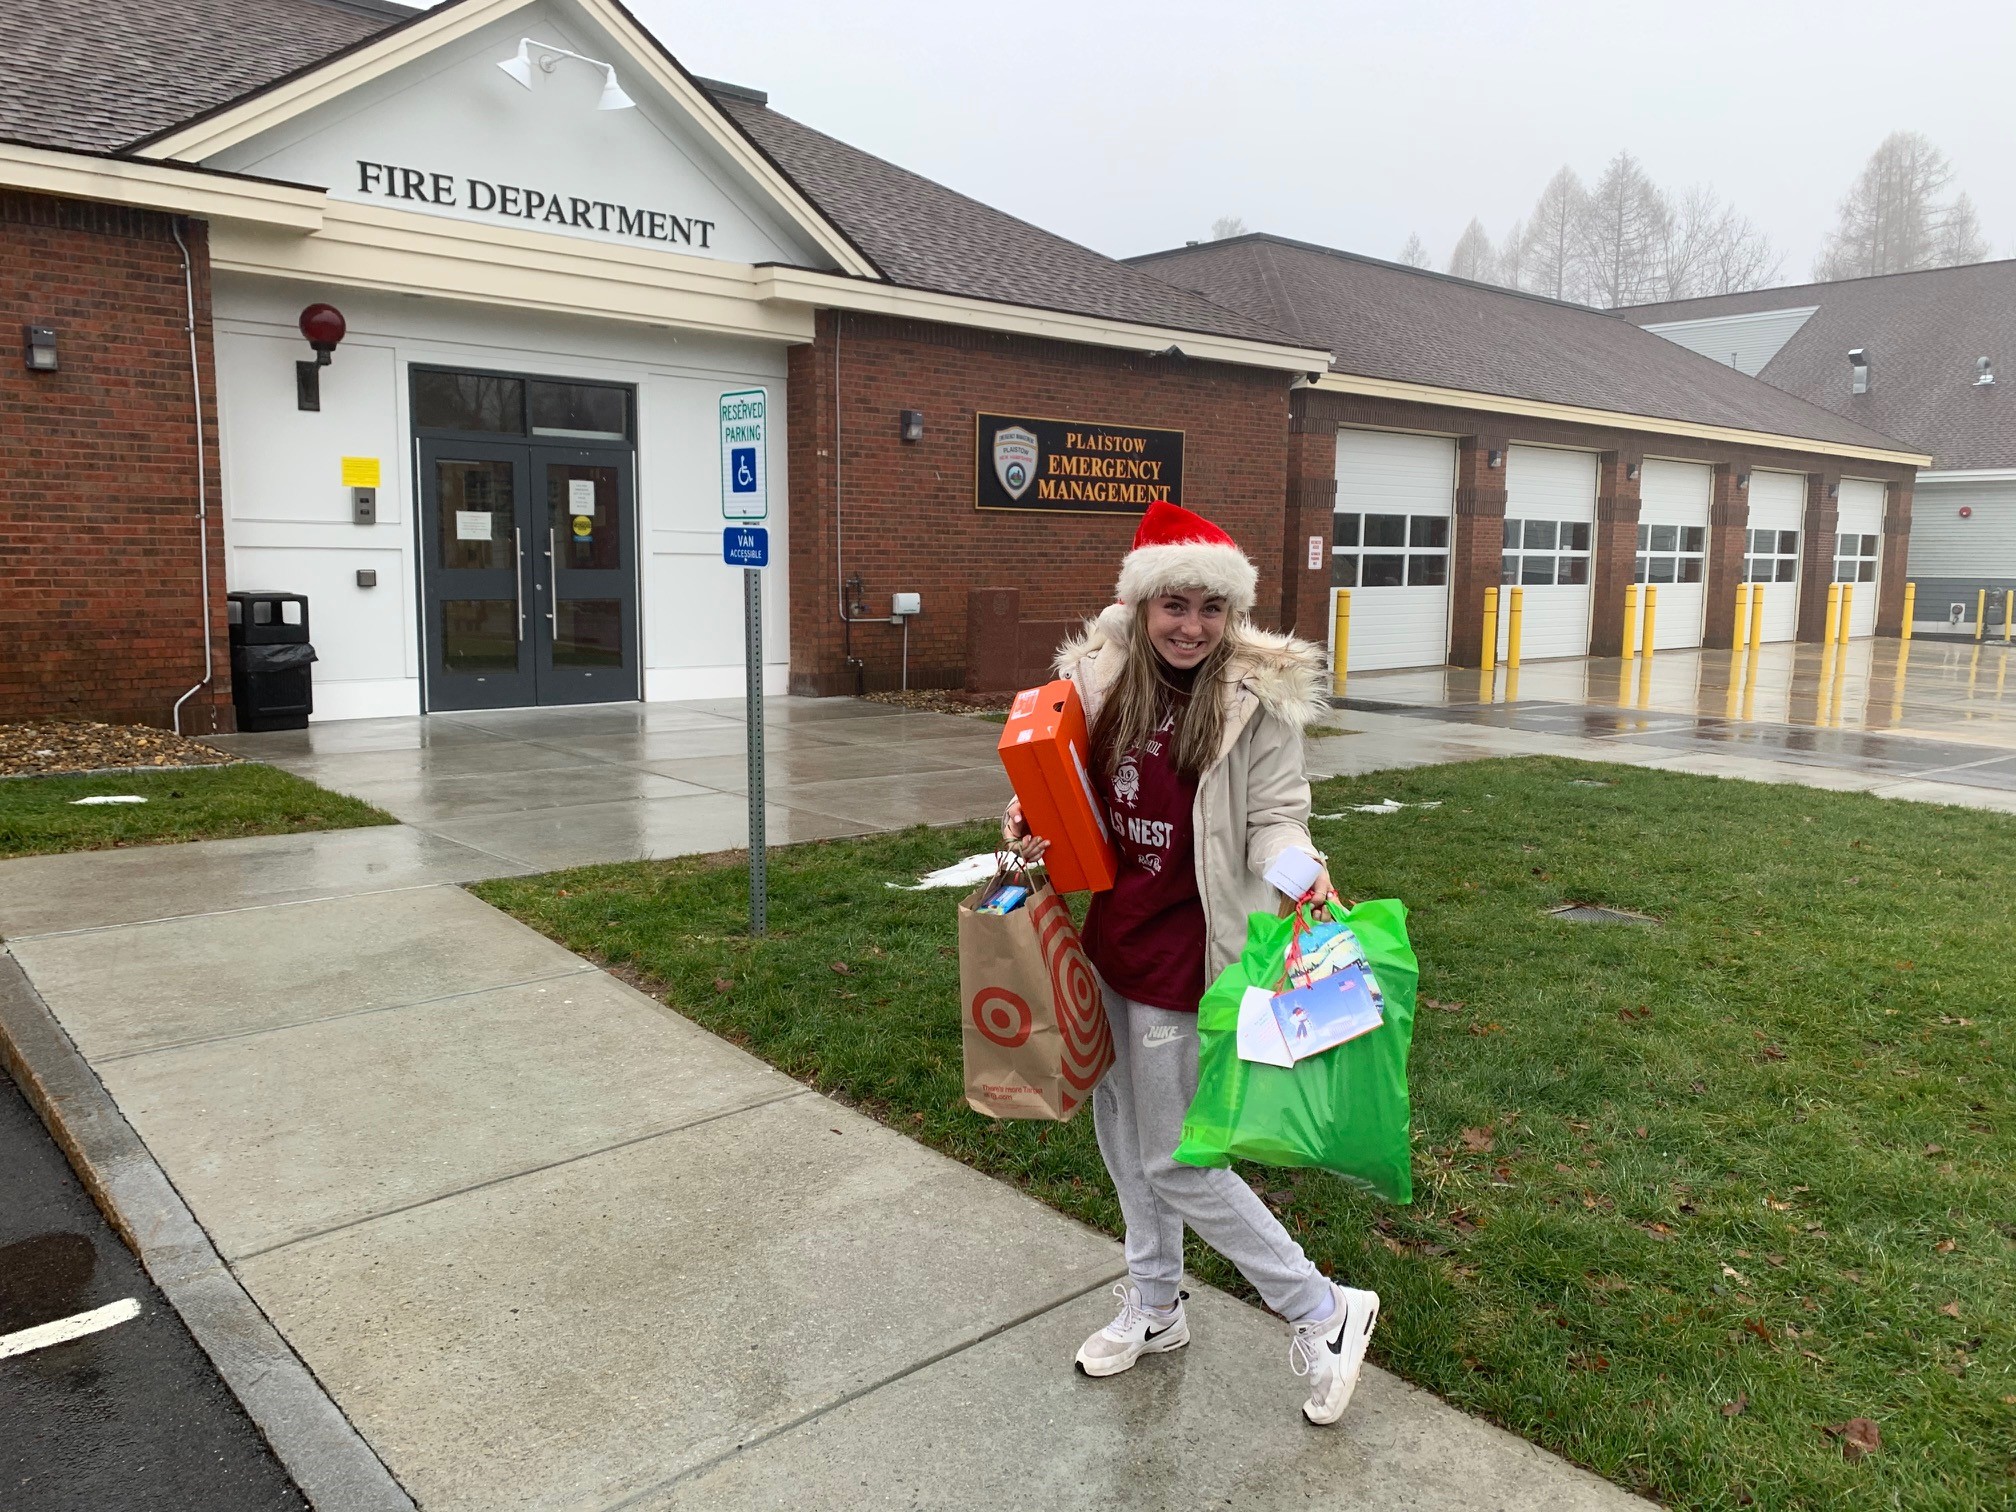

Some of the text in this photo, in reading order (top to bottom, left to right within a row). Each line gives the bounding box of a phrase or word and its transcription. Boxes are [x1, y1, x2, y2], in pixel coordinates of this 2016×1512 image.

[356, 160, 715, 249] FIRE DEPARTMENT
[722, 402, 763, 421] RESERVED
[725, 425, 761, 443] PARKING
[1066, 432, 1147, 453] PLAISTOW
[1048, 454, 1162, 481] EMERGENCY
[1038, 478, 1171, 503] MANAGEMENT
[737, 534, 754, 548] VAN
[730, 549, 762, 559] ACCESSIBLE
[1108, 805, 1174, 850] LS NEST
[1148, 1025, 1179, 1039] NIKE
